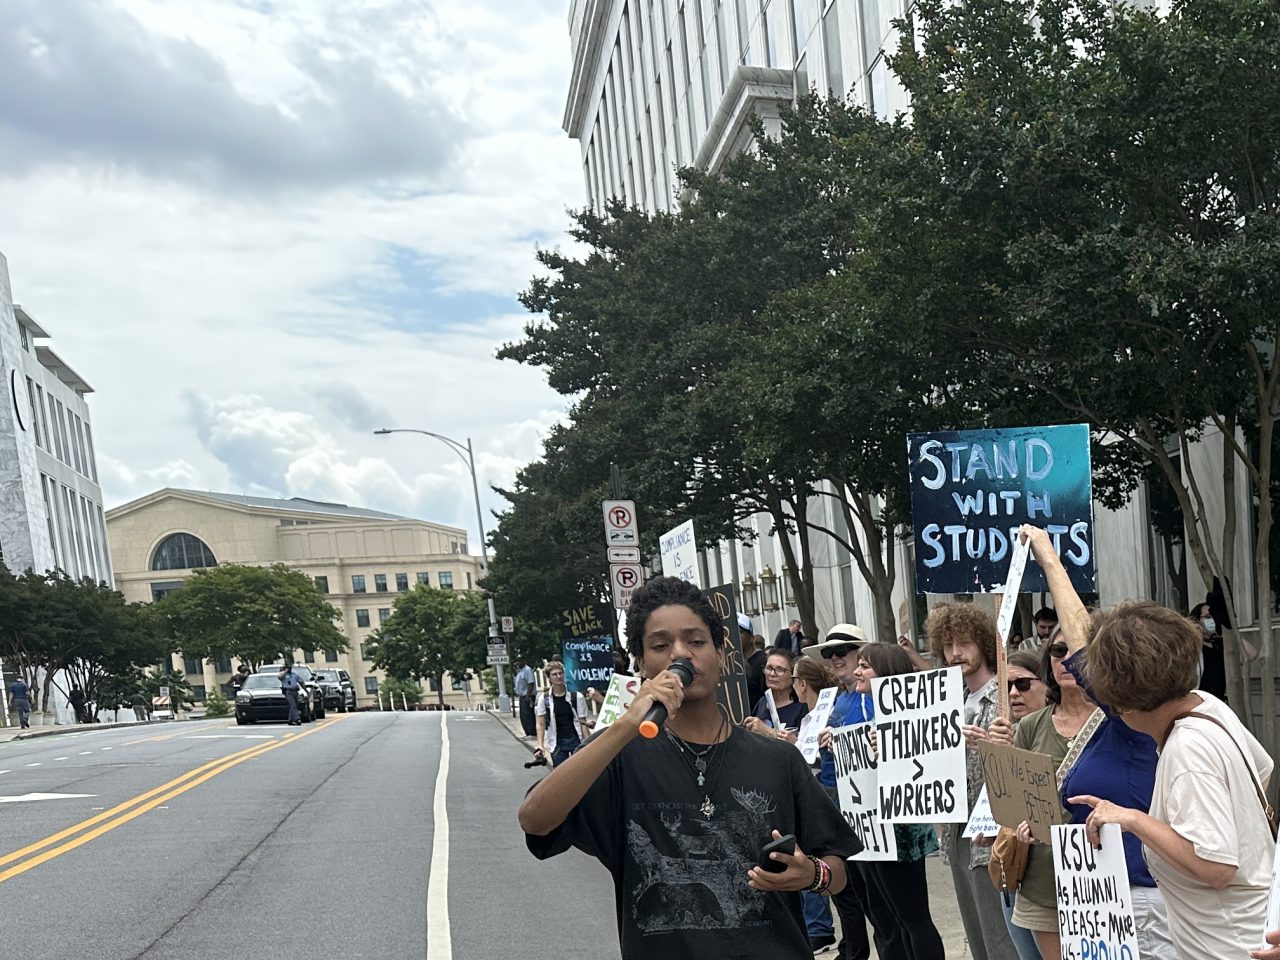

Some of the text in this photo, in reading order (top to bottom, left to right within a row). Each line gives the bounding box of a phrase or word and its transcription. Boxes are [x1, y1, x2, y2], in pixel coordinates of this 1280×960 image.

[920, 438, 1053, 490] STAND
[952, 489, 1052, 519] WITH
[662, 528, 691, 555] COMPLIANCE
[921, 521, 1090, 568] STUDTS
[673, 552, 681, 568] IS
[563, 605, 595, 626] SAVE
[571, 620, 603, 636] BLACK
[570, 667, 614, 681] VIOLENCE
[878, 670, 948, 715] CREATE
[832, 724, 878, 779] STUDENTS
[876, 709, 962, 763] THINKERS
[1025, 760, 1050, 796] Expect
[879, 779, 956, 820] WORKERS
[1058, 826, 1096, 872] KSU
[1072, 875, 1124, 908] ALUMNI,
